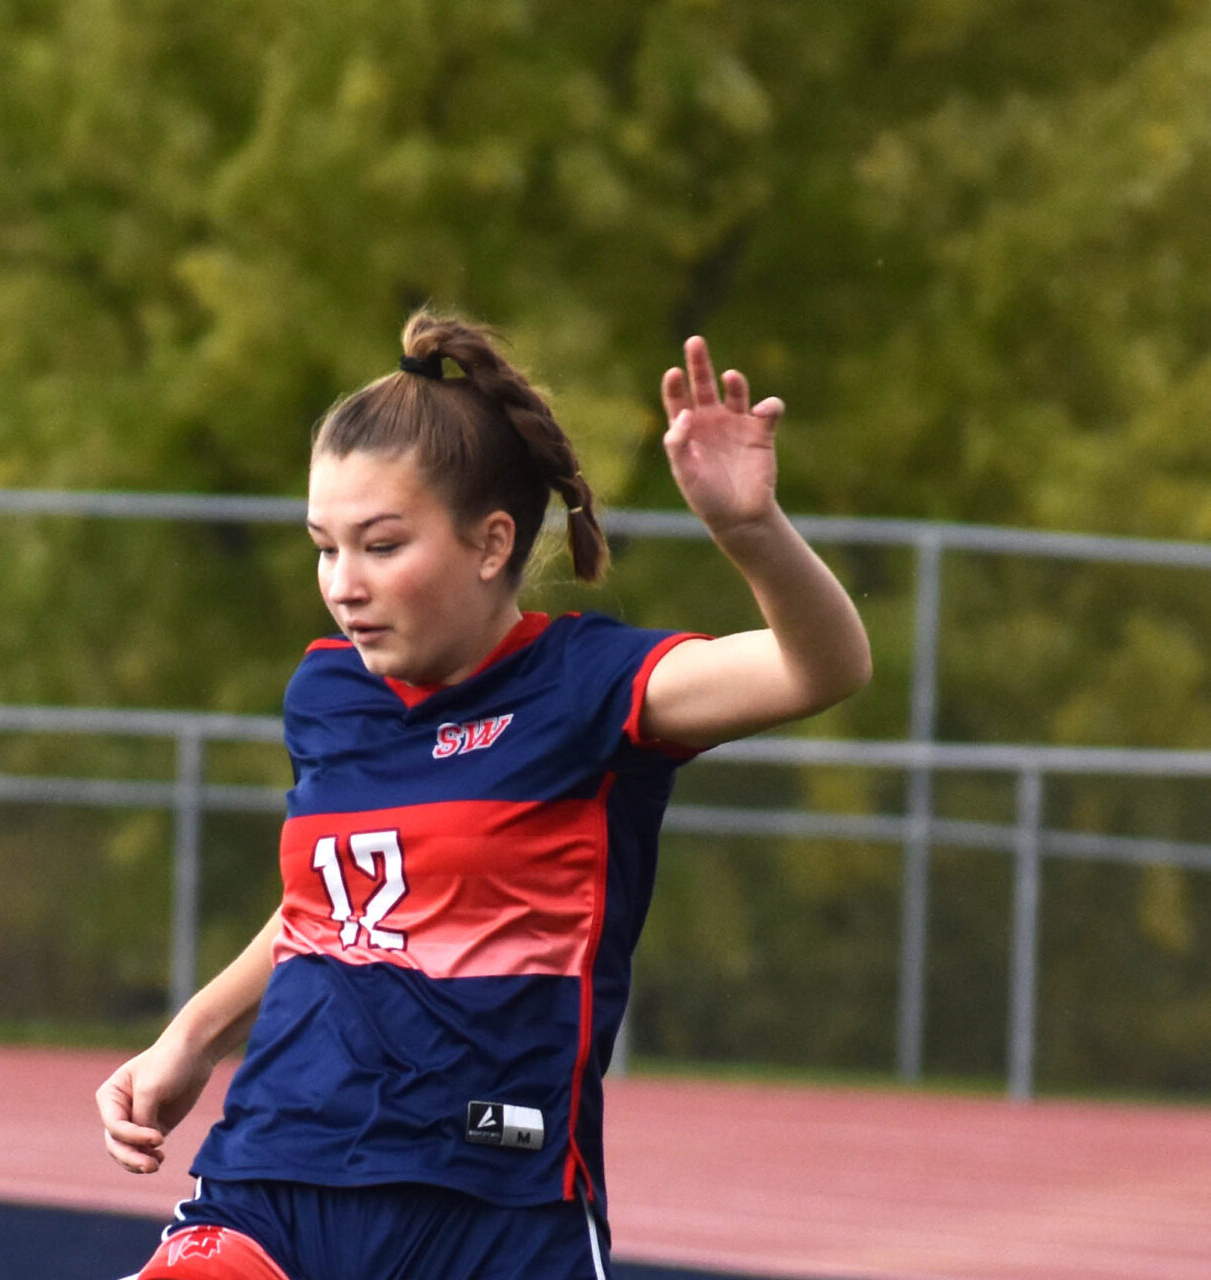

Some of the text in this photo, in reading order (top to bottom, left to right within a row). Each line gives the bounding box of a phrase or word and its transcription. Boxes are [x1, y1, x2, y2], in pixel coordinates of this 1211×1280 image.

[432, 713, 514, 760] SW
[311, 828, 410, 952] 12
[517, 1131, 531, 1144] M
